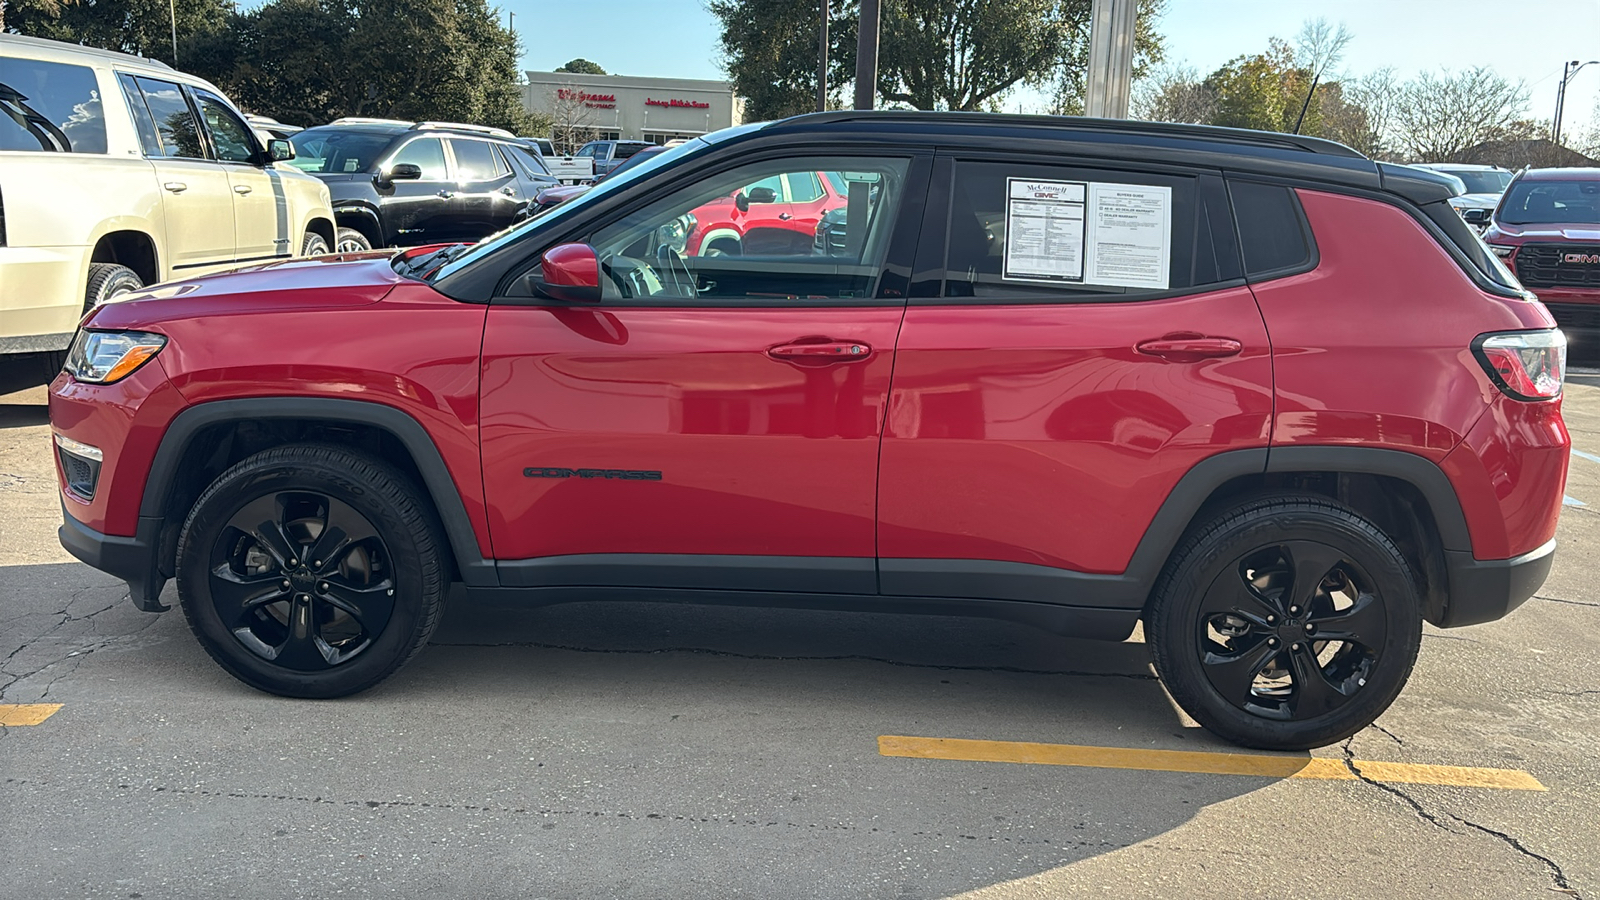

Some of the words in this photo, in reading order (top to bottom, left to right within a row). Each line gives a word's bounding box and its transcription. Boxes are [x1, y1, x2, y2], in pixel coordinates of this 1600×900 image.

[1027, 184, 1068, 194] McConnell
[1565, 253, 1600, 264] GM
[523, 467, 663, 481] COMPASS
